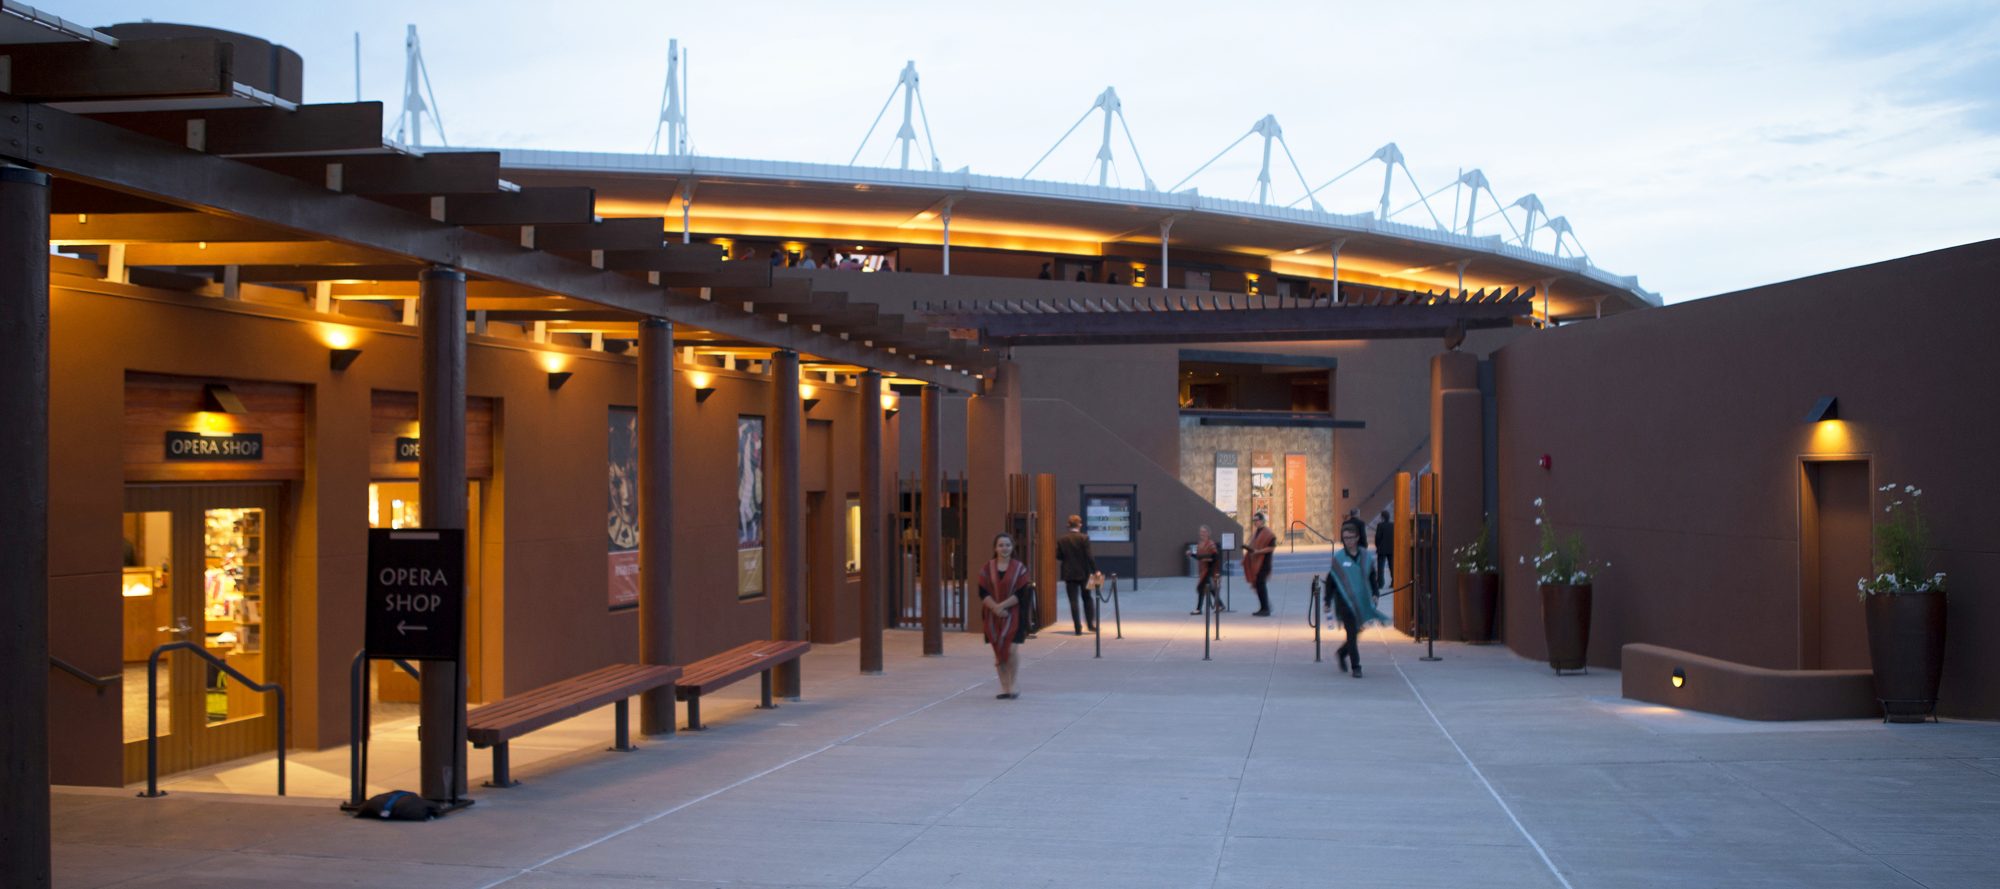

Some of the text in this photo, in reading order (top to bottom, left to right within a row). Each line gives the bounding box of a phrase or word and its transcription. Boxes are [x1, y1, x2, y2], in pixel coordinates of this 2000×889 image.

[171, 438, 260, 456] OPERA SHOP
[400, 443, 420, 457] OPE
[379, 567, 449, 587] OPERA
[385, 594, 441, 613] SHOP
